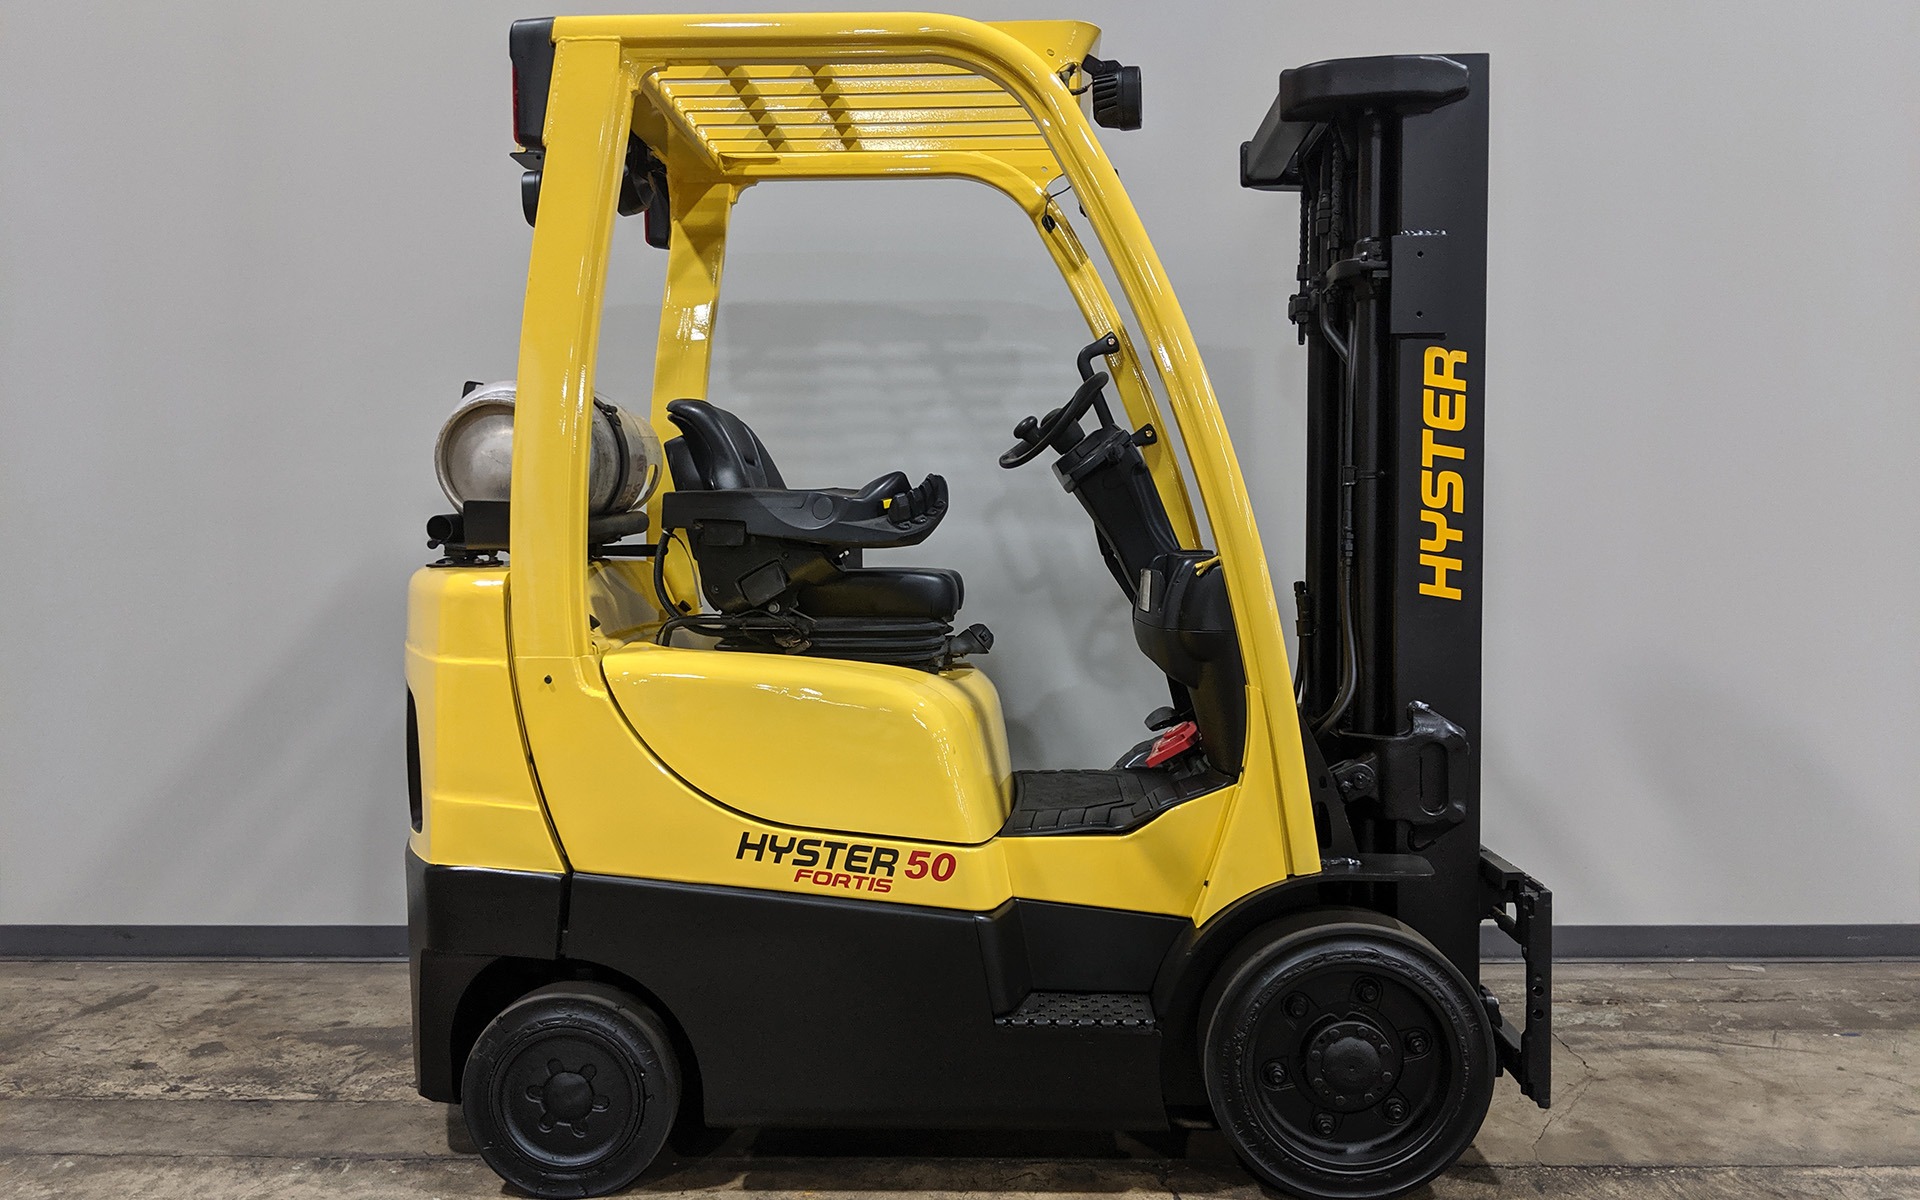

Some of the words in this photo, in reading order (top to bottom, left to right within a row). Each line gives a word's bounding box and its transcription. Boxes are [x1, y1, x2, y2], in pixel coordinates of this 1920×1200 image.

[1419, 346, 1467, 601] HYSTER
[736, 832, 899, 877] HYSTER
[904, 850, 957, 882] 50
[794, 869, 893, 893] FORTIS
